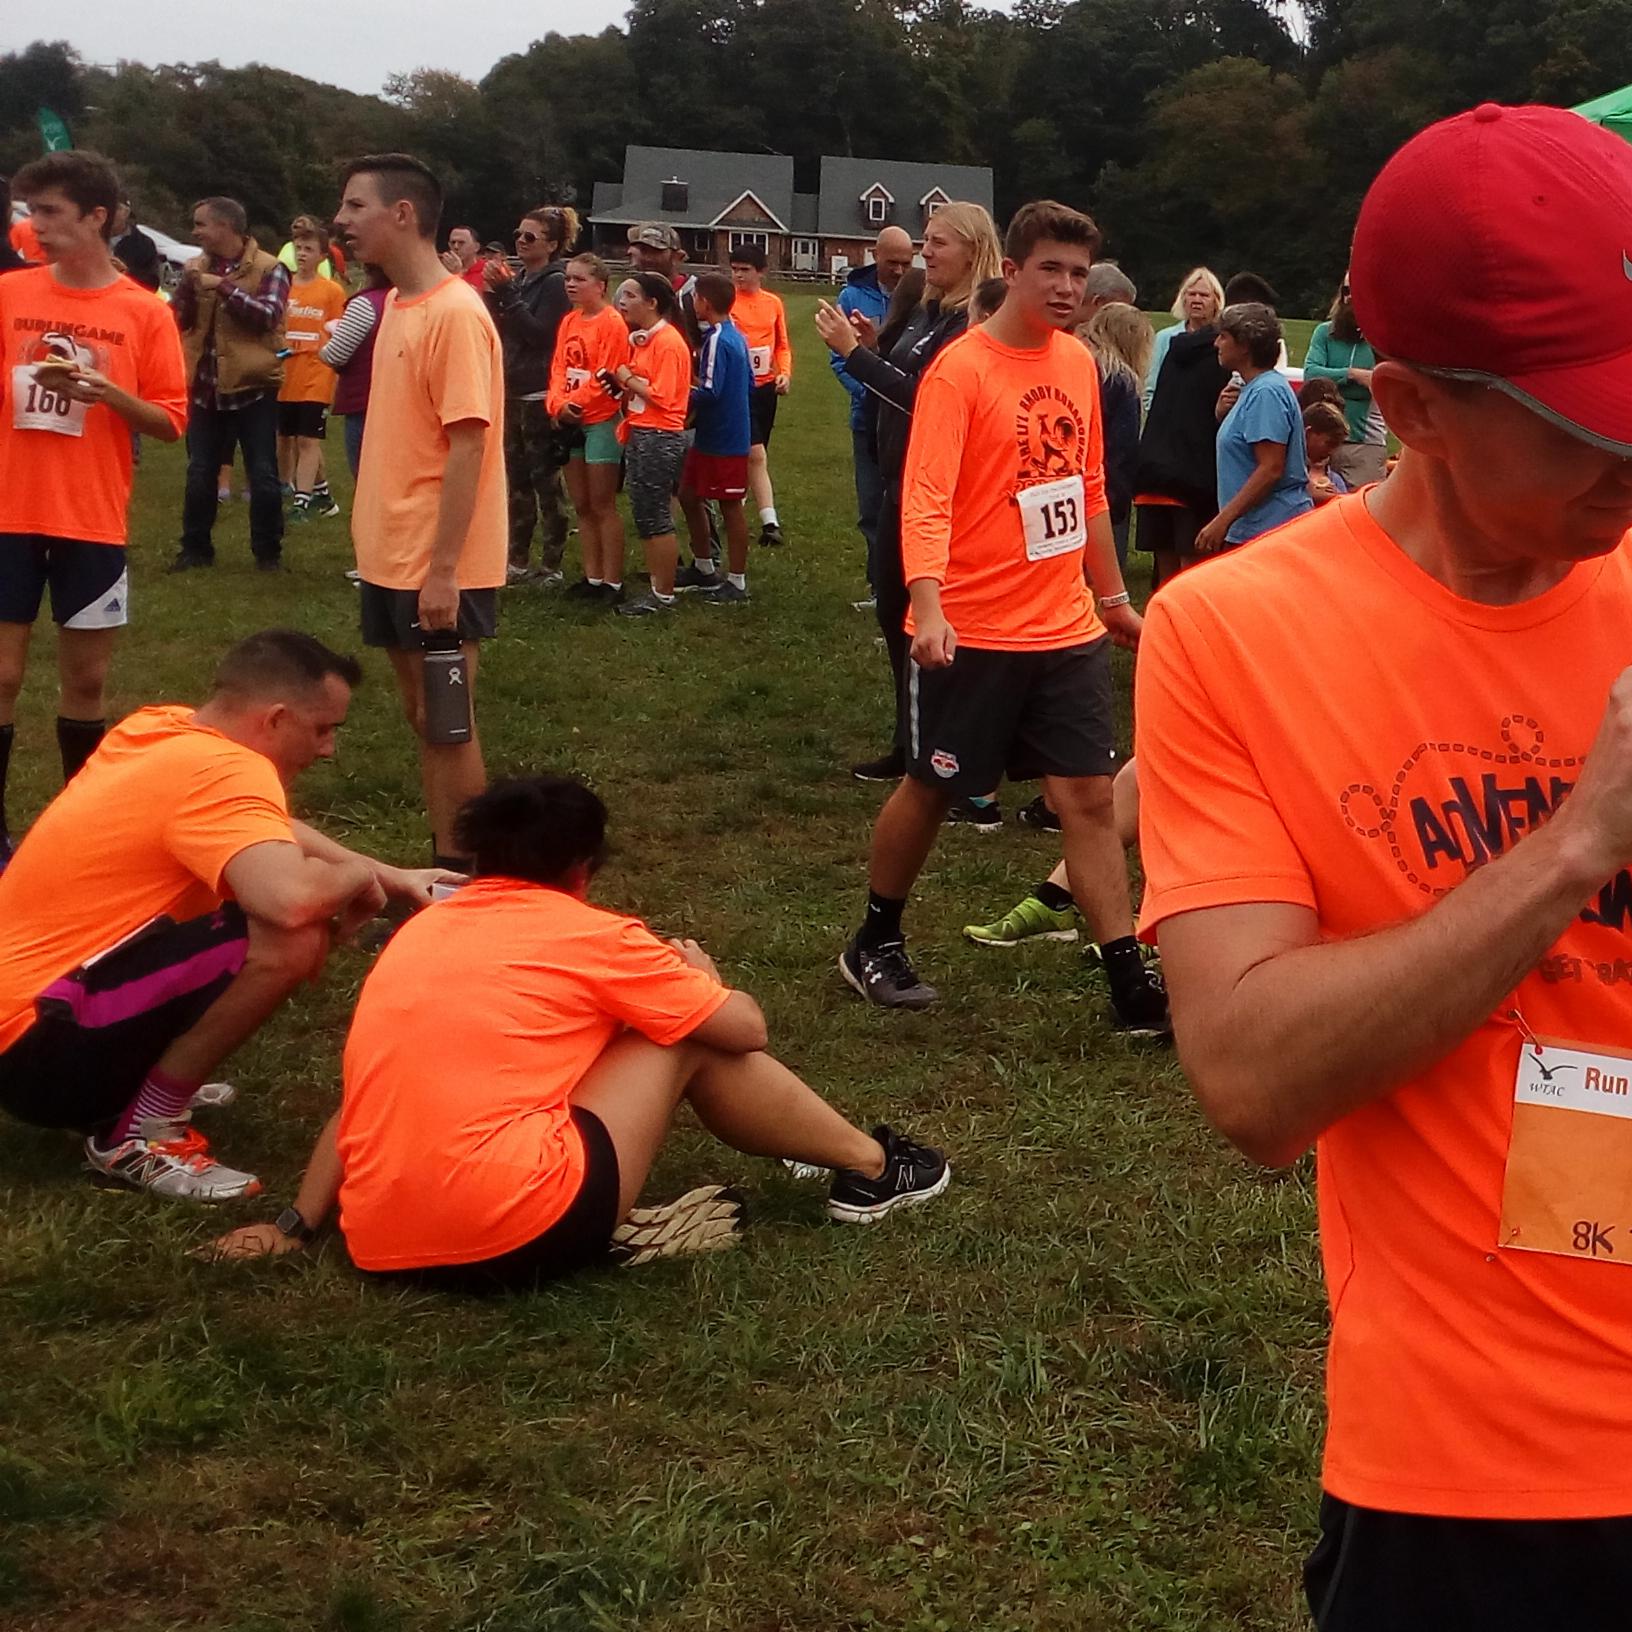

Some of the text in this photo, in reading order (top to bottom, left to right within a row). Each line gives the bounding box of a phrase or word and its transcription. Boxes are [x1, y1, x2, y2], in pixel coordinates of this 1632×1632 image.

[13, 318, 125, 346] BURLINGAME
[1040, 497, 1078, 539] 153
[1529, 1083, 1565, 1097] WTAC
[1584, 1066, 1629, 1096] Run
[1572, 1220, 1616, 1256] 8K
